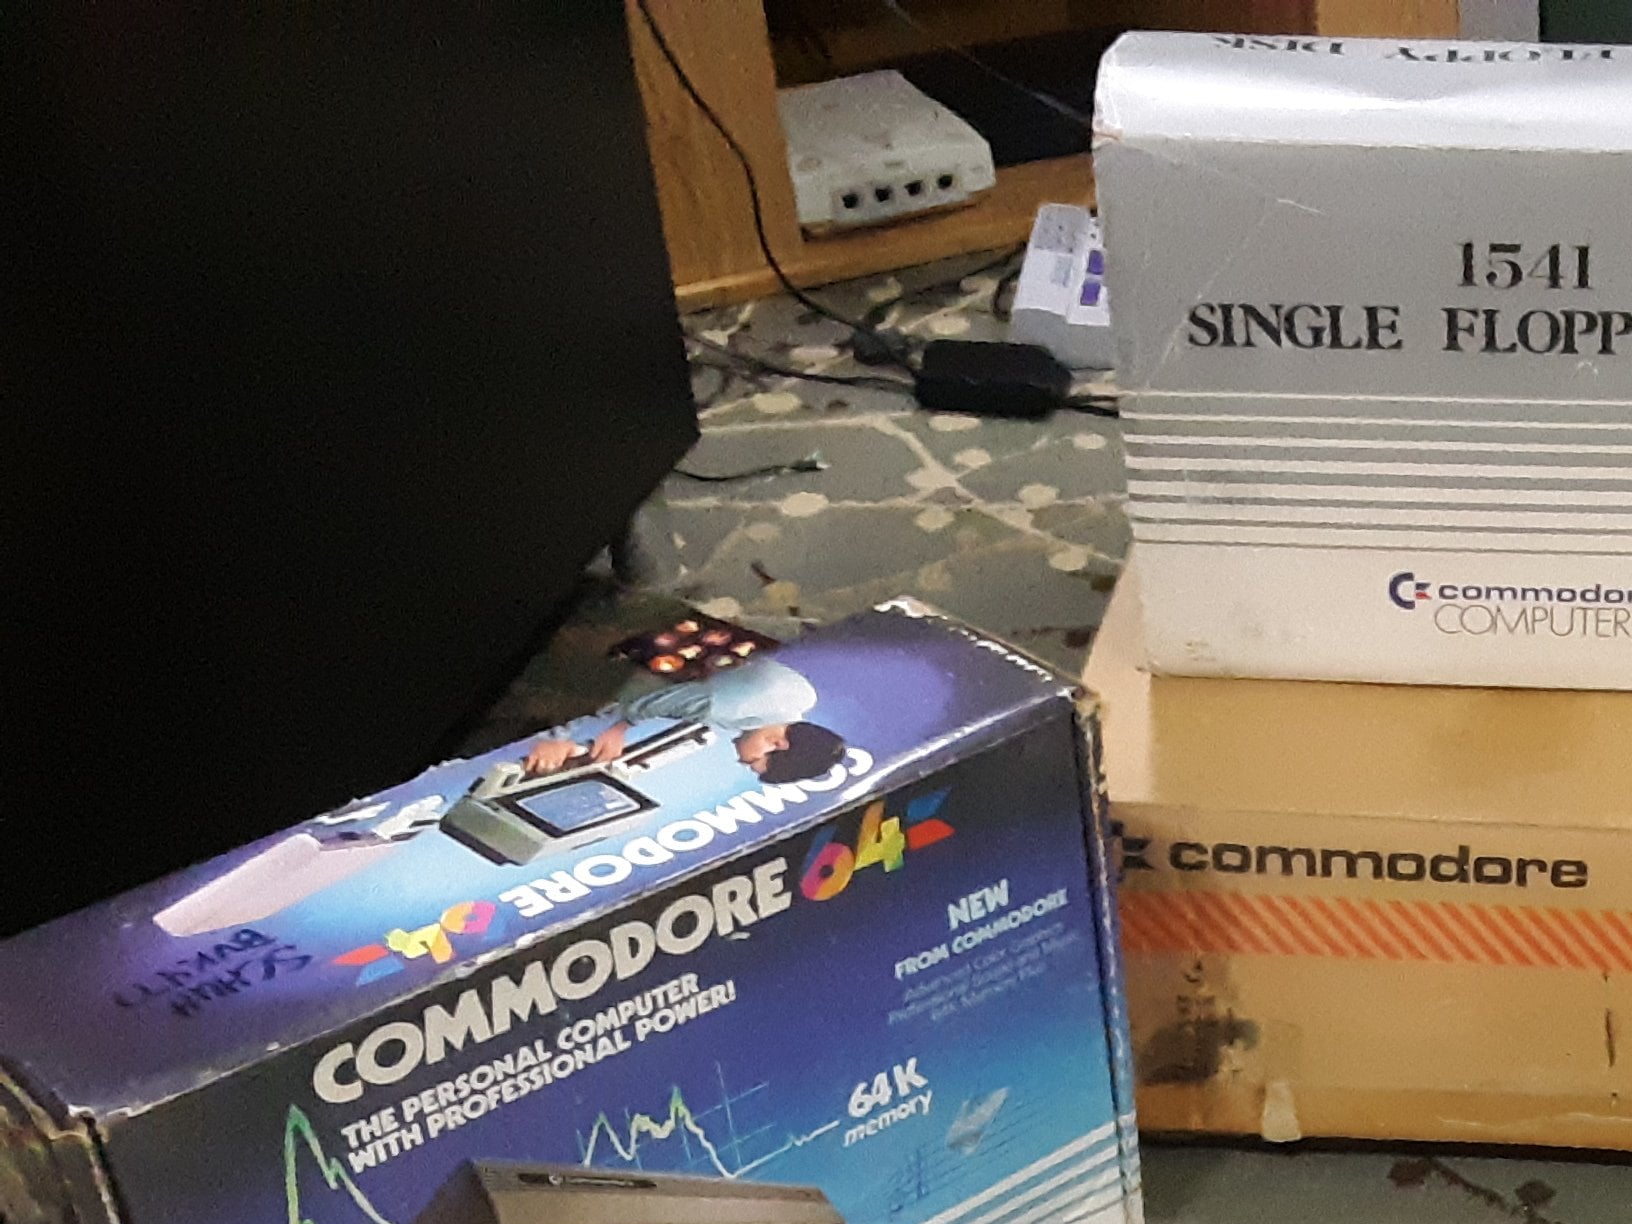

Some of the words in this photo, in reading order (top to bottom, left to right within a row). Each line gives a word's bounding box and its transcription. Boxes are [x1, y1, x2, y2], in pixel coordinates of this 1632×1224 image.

[1457, 241, 1592, 290] 1541
[1187, 302, 1402, 351] SINGLE
[1434, 604, 1632, 638] COMPUTER
[1168, 842, 1589, 889] commodore
[948, 878, 1009, 930] NEW
[313, 856, 793, 1104] COMMODORE
[799, 799, 906, 902] 64
[895, 943, 950, 980] FROM
[952, 888, 1069, 955] COMMODORE
[342, 1108, 400, 1150] THE
[401, 1031, 553, 1126] PERSONAL
[557, 971, 700, 1050] COMPUTER
[347, 1127, 425, 1175] WITH
[428, 1034, 632, 1146] PROFESSIONAL
[636, 979, 737, 1043] POWER!
[842, 1089, 934, 1148] memory
